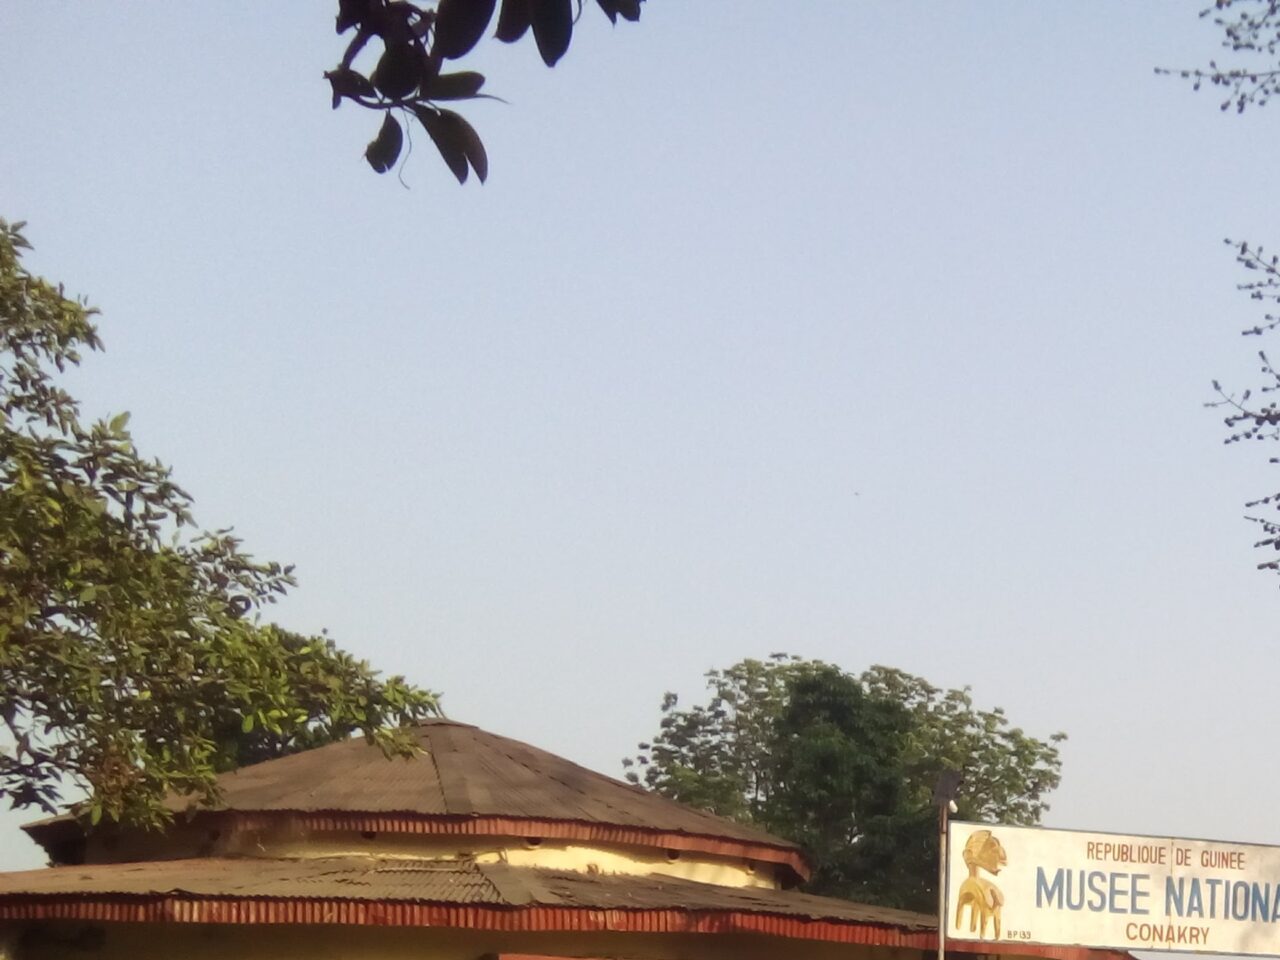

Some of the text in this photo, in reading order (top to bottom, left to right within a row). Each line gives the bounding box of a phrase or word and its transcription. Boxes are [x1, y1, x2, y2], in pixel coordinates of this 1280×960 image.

[1086, 841, 1246, 870] REPUBLIQUE DE GUINEE
[1036, 866, 1150, 915] MUSEE
[1125, 922, 1210, 945] CONAKRY
